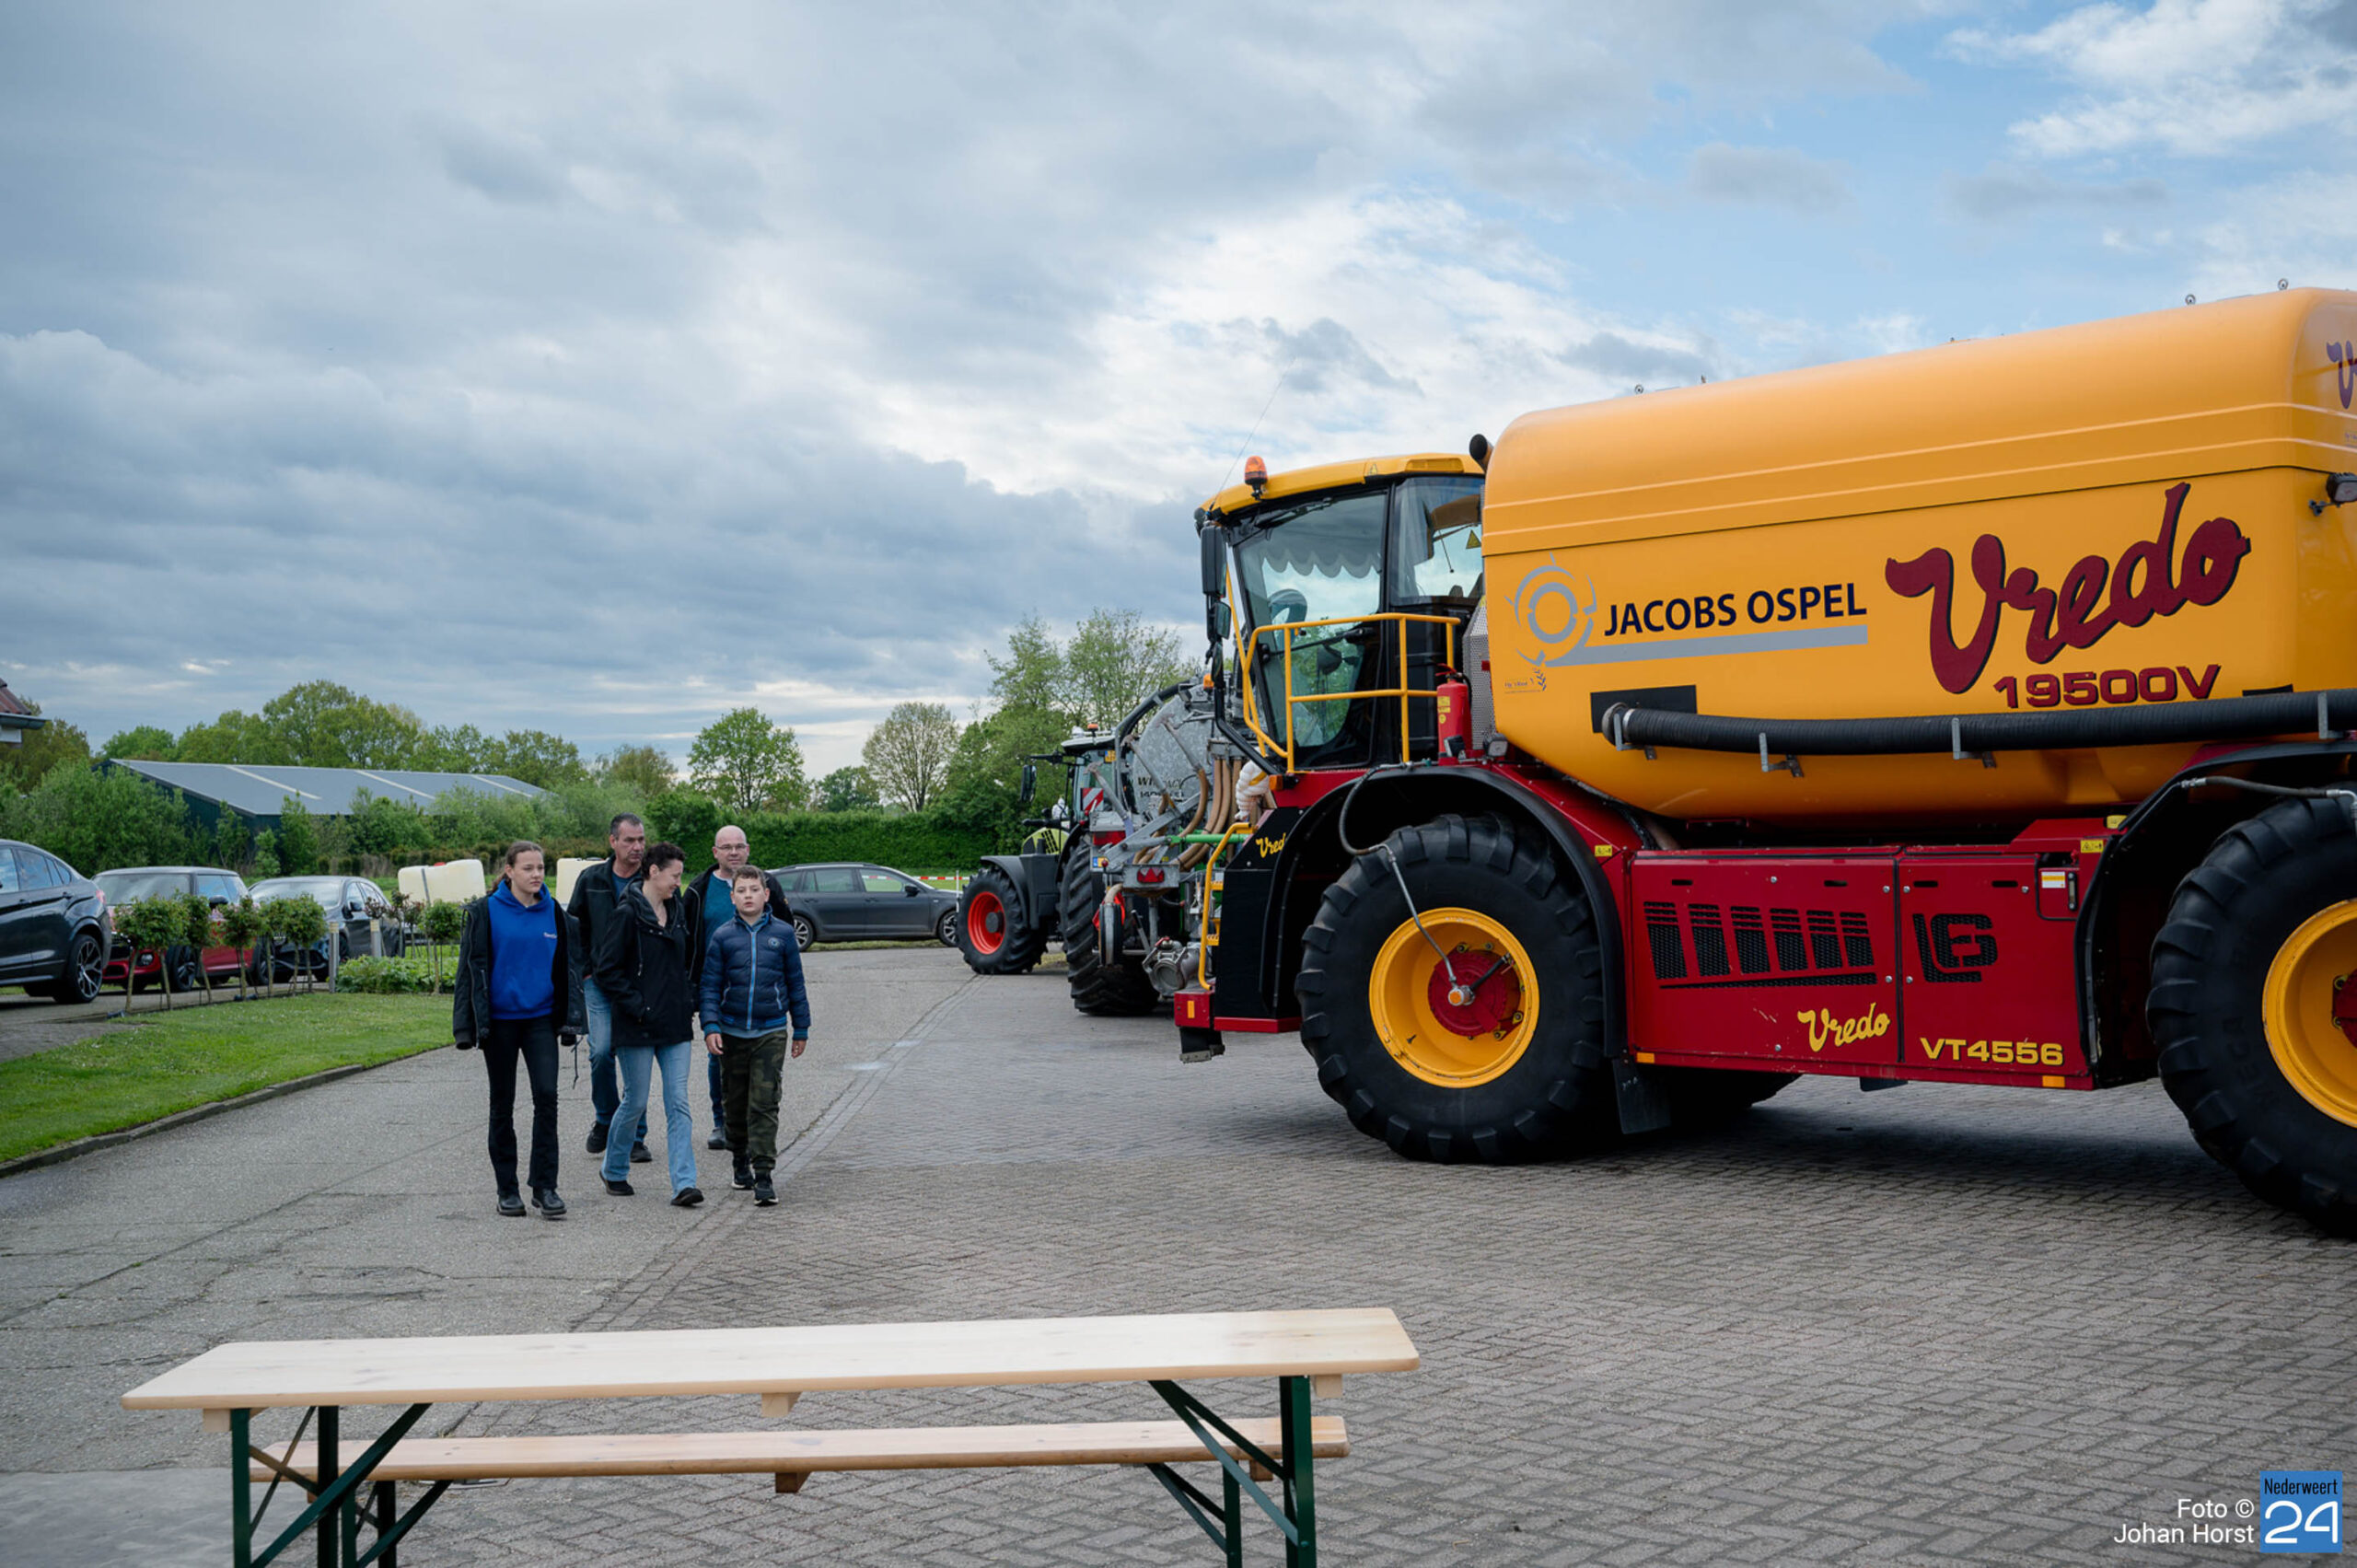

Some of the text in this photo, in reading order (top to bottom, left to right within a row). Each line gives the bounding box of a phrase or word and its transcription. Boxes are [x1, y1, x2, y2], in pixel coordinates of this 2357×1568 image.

[1604, 582, 1867, 636] JACOBS OSPEL
[1885, 482, 2251, 694] Vredo
[1993, 664, 2222, 709] 19500V
[1256, 832, 1287, 858] Vred
[1797, 1002, 1890, 1052] Vredo
[1920, 1037, 2064, 1066] VT4556
